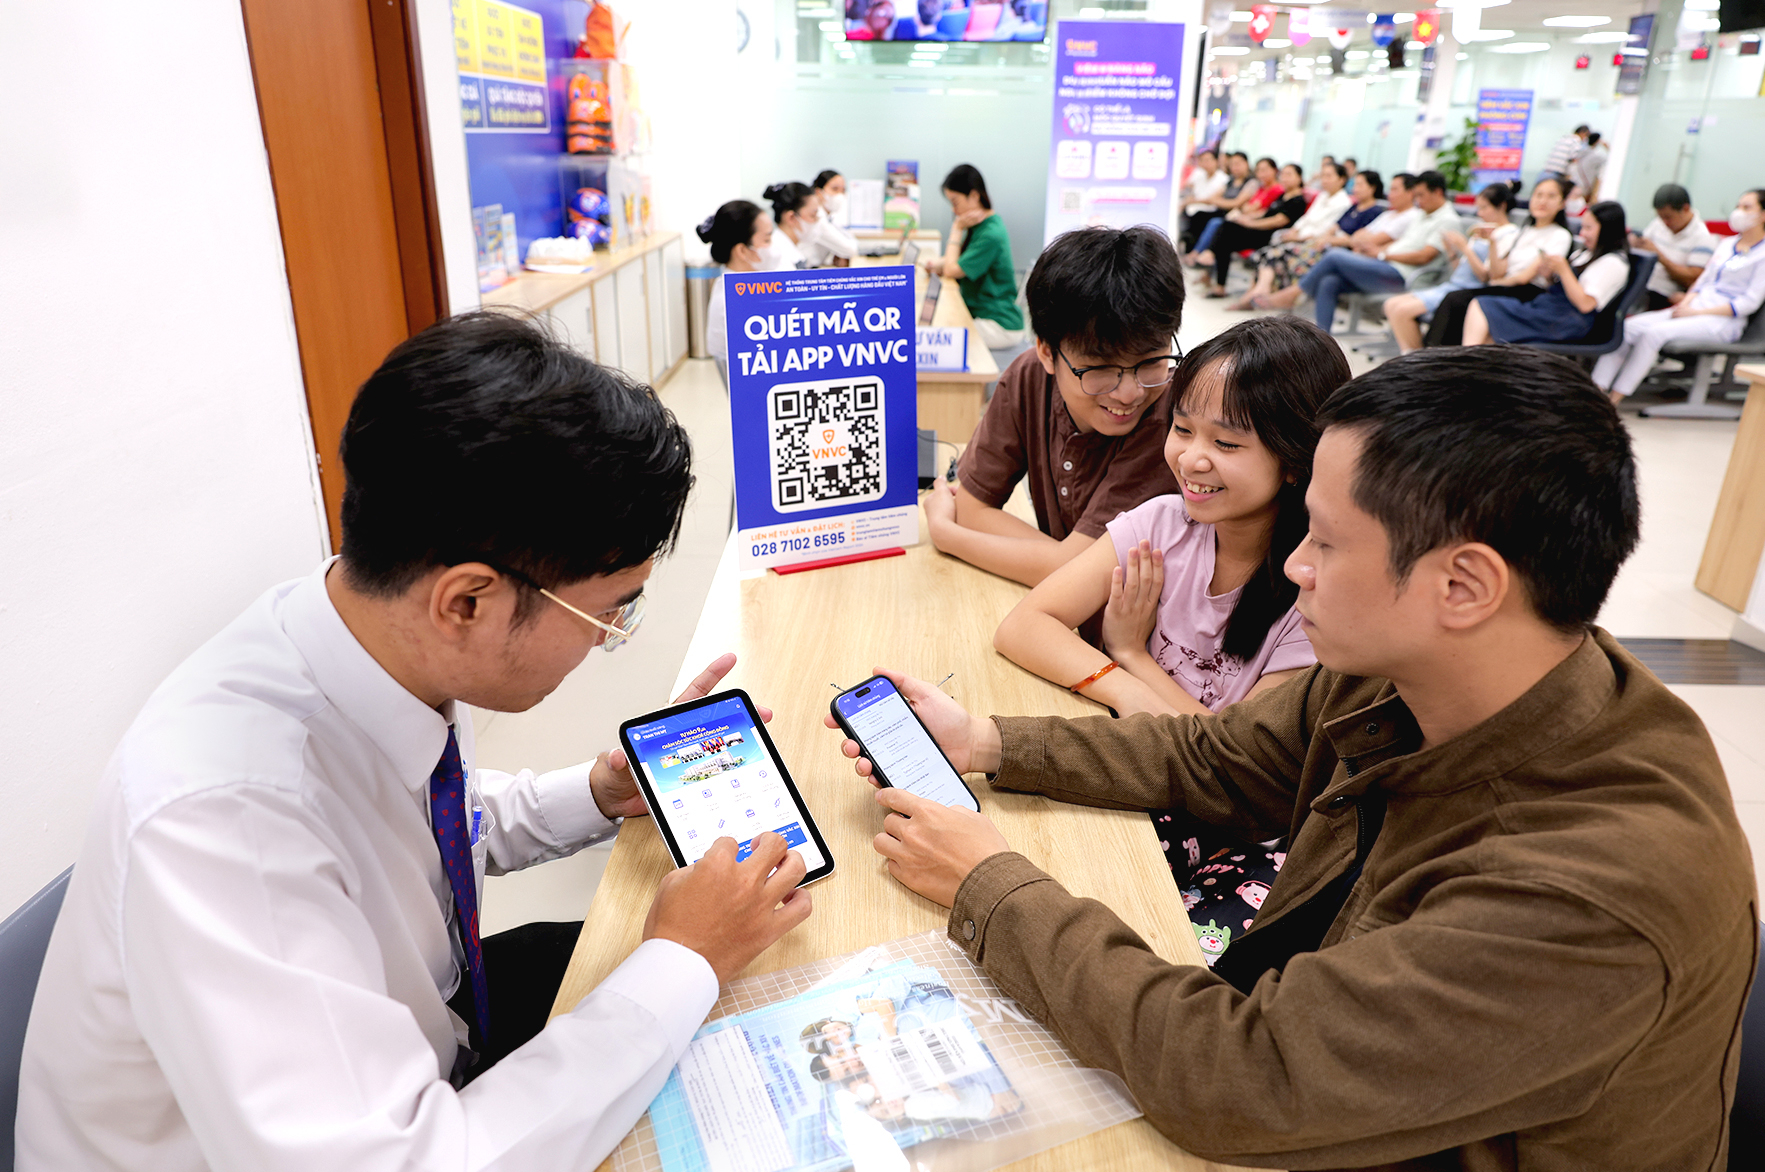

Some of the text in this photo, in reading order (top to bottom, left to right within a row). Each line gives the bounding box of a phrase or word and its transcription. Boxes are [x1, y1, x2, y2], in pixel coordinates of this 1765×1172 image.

[747, 282, 783, 294] VNVC
[844, 282, 860, 290] LƯỢNG
[874, 280, 885, 288] ĐẦU
[885, 280, 894, 288] VIỆT
[744, 302, 901, 341] QUÉT MÃ QR
[926, 328, 953, 346] VẤN
[737, 339, 908, 376] TẢI APP VNVC
[812, 446, 847, 460] VNVC
[751, 532, 767, 541] LIÊN
[768, 530, 778, 538] HỆ
[780, 528, 790, 537] TƯ
[790, 526, 806, 536] VẤN
[813, 523, 826, 533] ĐẶT
[752, 532, 846, 556] 028 7102 6595
